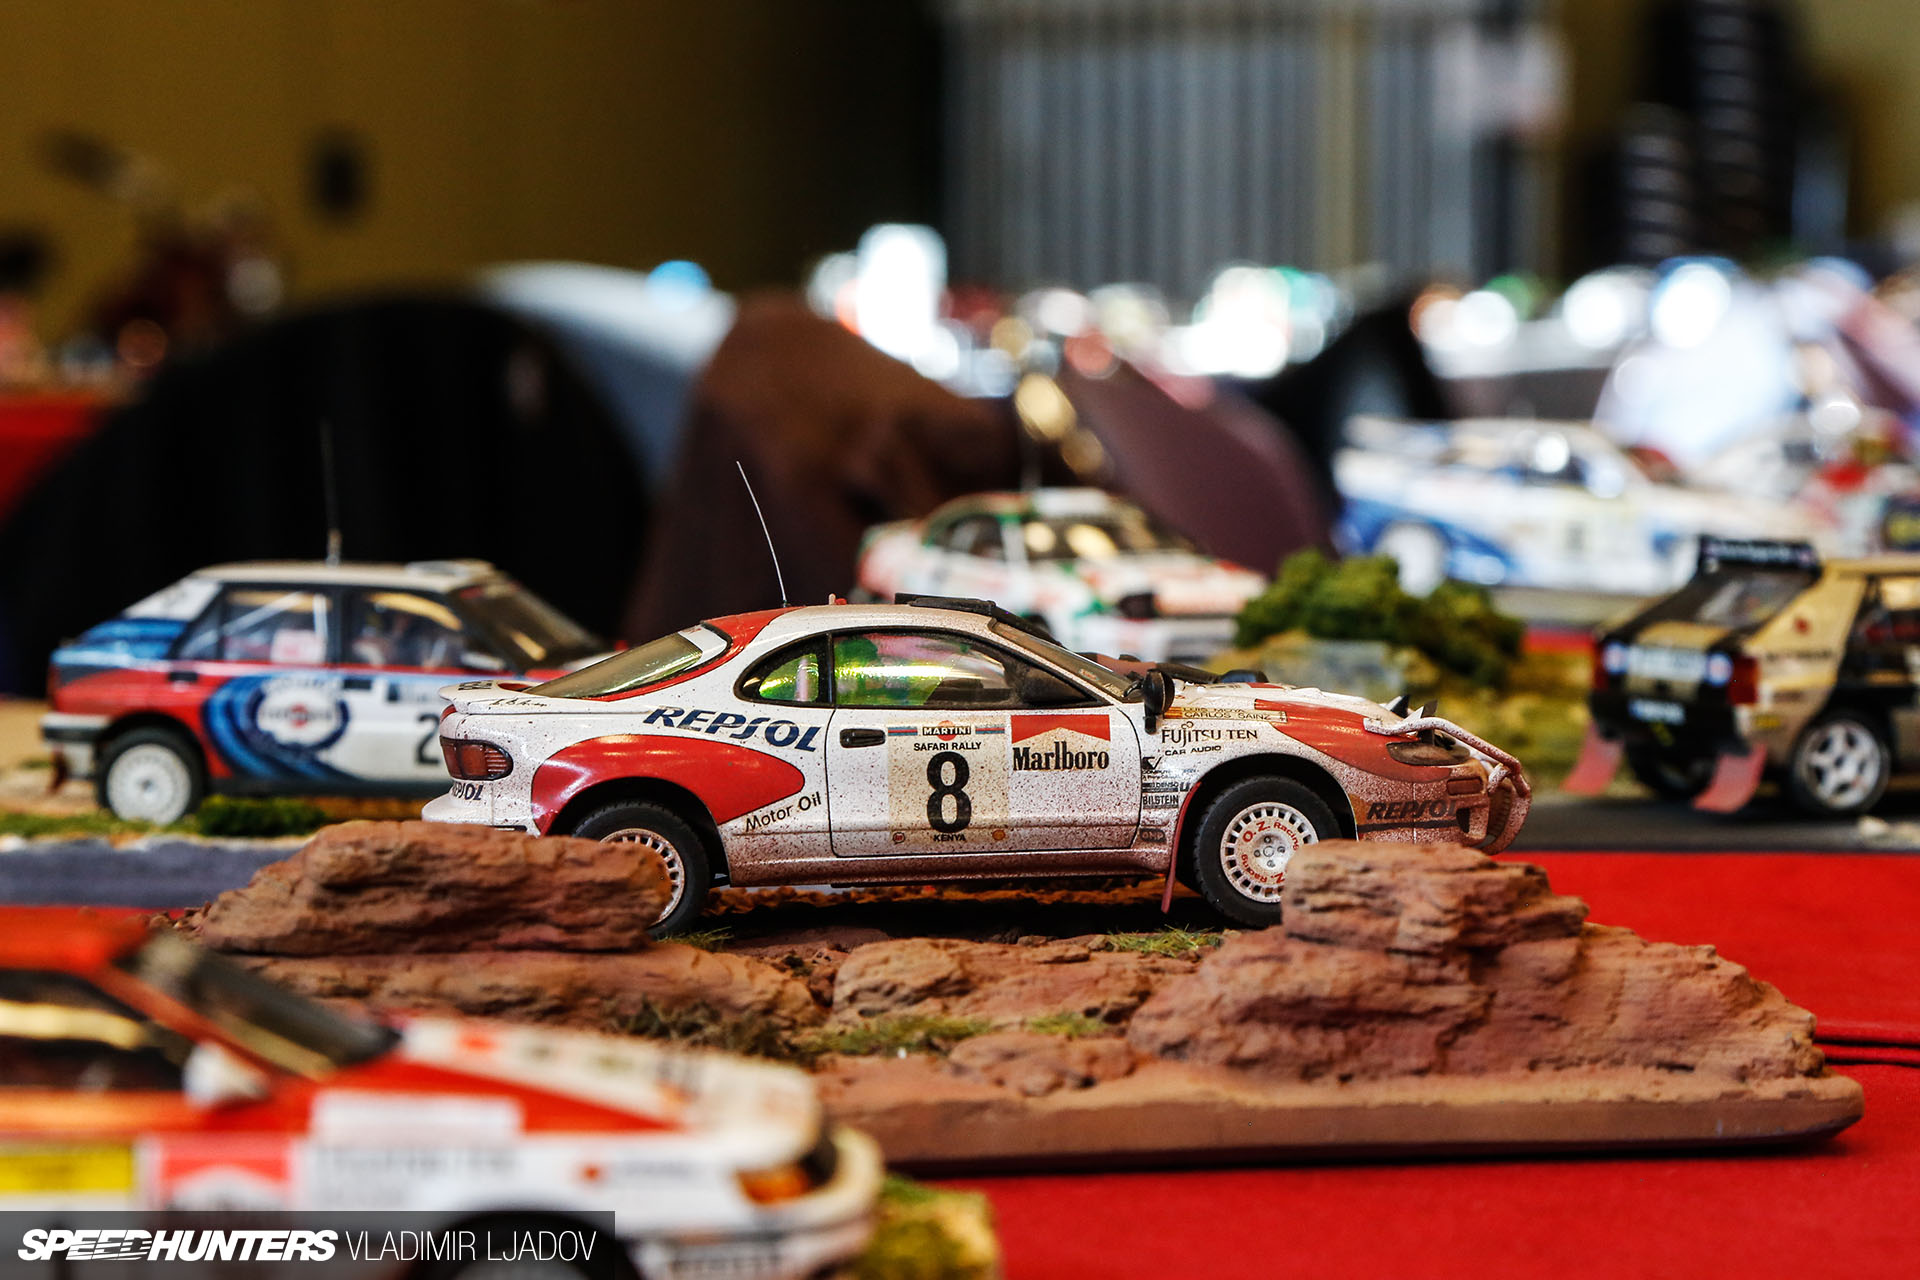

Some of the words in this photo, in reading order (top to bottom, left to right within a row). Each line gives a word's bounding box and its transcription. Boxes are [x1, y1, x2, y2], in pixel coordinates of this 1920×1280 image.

[643, 705, 821, 752] REPSOL
[924, 727, 970, 735] MARTINI
[1161, 722, 1221, 747] FUJITSU
[1226, 730, 1258, 739] TEN
[914, 743, 949, 751] SAFARI
[951, 742, 981, 750] RALLY
[1012, 741, 1110, 771] Marlboro
[1191, 745, 1222, 753] AUDIO
[926, 751, 972, 833] 8
[745, 805, 793, 832] Motor
[799, 791, 821, 811] Oil
[933, 834, 967, 842] KENYA
[1273, 821, 1299, 850] Racing
